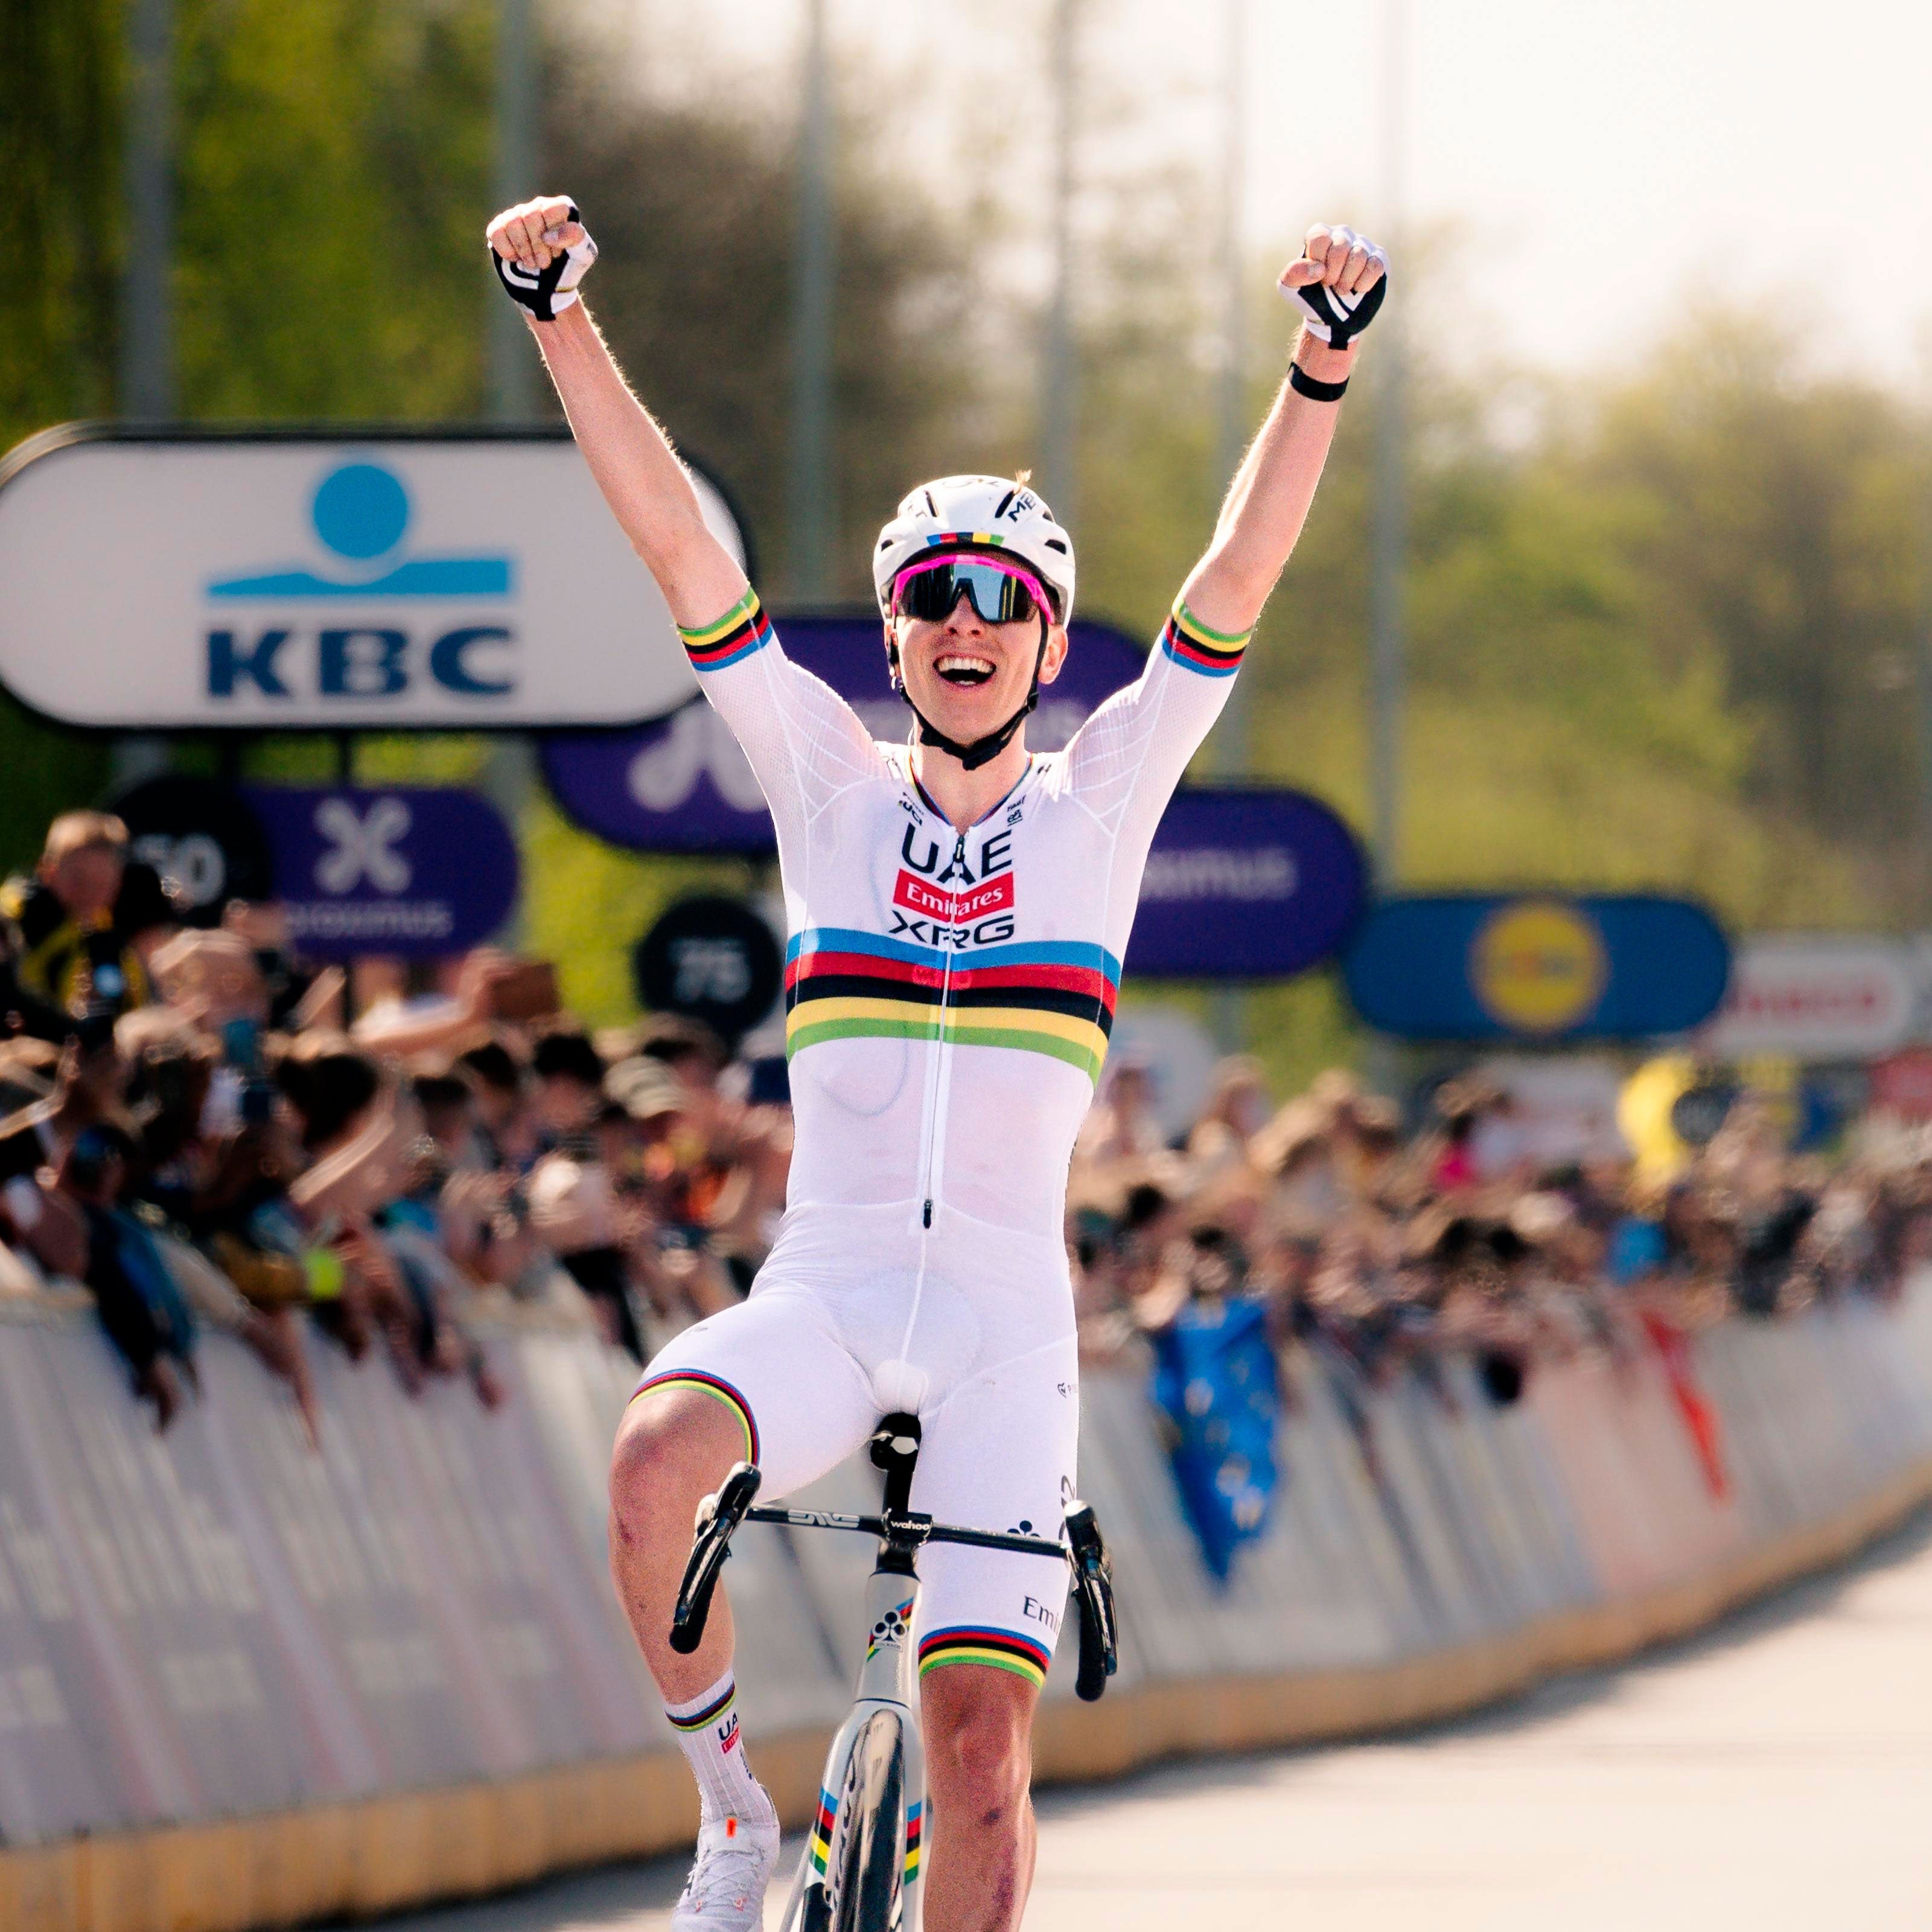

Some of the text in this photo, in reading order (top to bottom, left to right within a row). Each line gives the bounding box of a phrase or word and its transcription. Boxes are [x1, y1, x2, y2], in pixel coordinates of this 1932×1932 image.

[208, 625, 517, 698] KBC
[901, 821, 1013, 885] UAE
[907, 881, 1004, 917] Emirates
[888, 910, 1015, 949] XRG
[890, 1519, 931, 1531] wahoo
